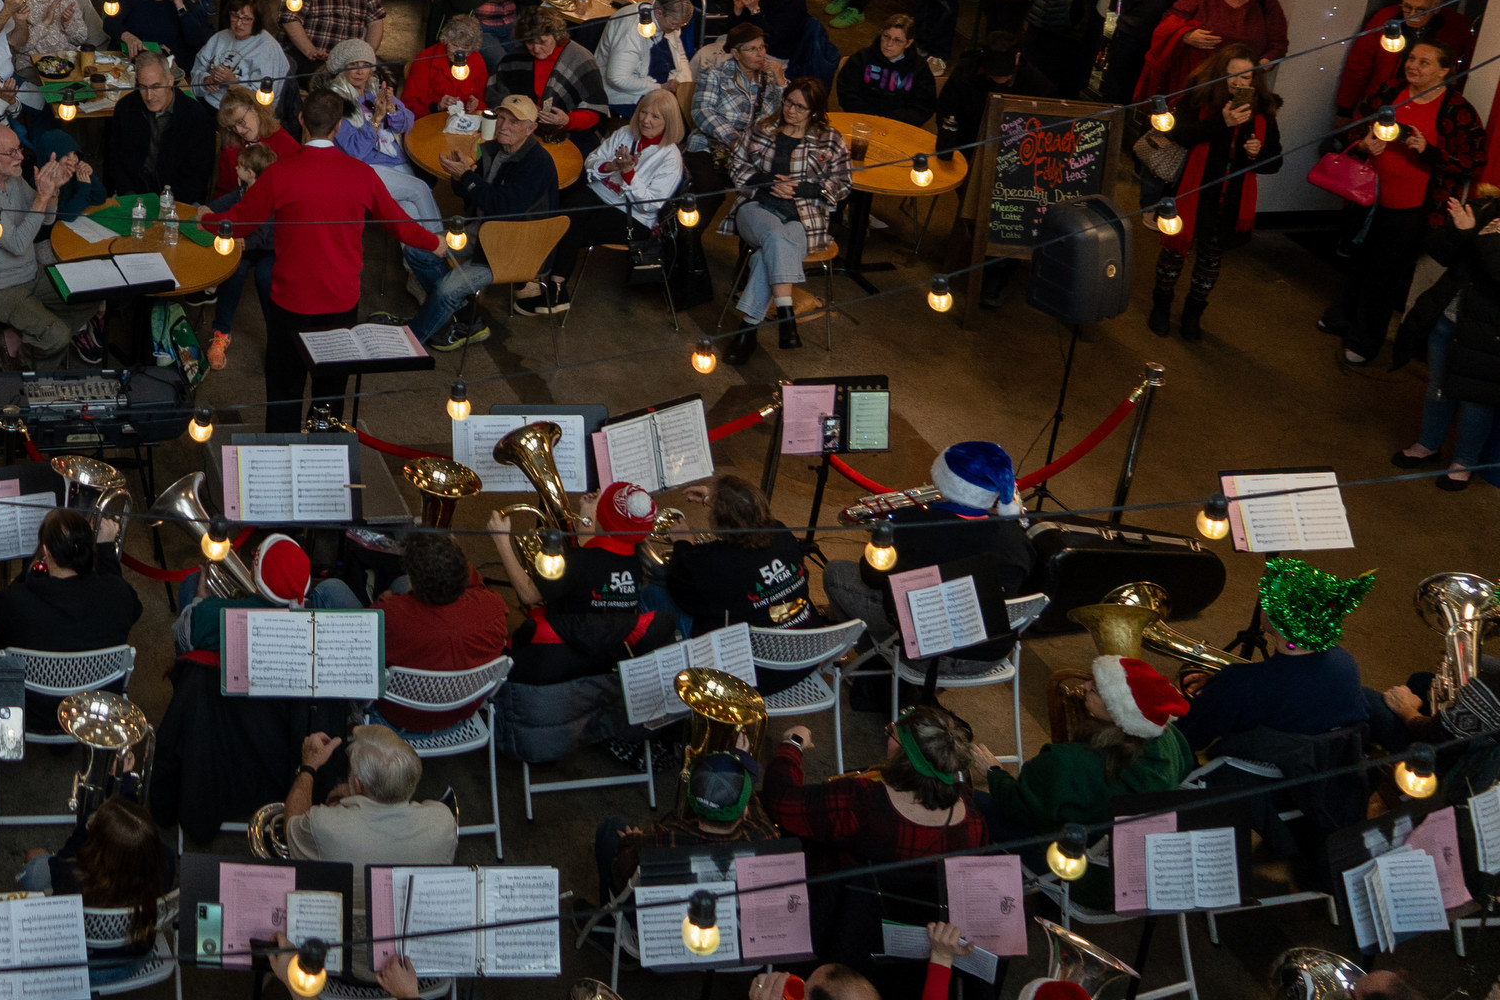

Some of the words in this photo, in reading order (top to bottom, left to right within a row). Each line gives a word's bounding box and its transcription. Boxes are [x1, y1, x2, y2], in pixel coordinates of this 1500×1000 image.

[863, 64, 915, 92] FIM
[1074, 120, 1096, 132] Fresh
[1019, 116, 1082, 168] Steady
[1069, 153, 1096, 170] Bubble
[992, 182, 1048, 206] Specialty
[1001, 211, 1022, 221] Latte
[1001, 230, 1022, 239] Latte
[609, 569, 635, 592] 50
[758, 557, 787, 587] 50
[773, 568, 793, 584] YEAR
[619, 585, 636, 594] YEAR
[752, 597, 770, 610] FLINT
[769, 586, 792, 603] FARMERS
[590, 600, 607, 608] FLINT
